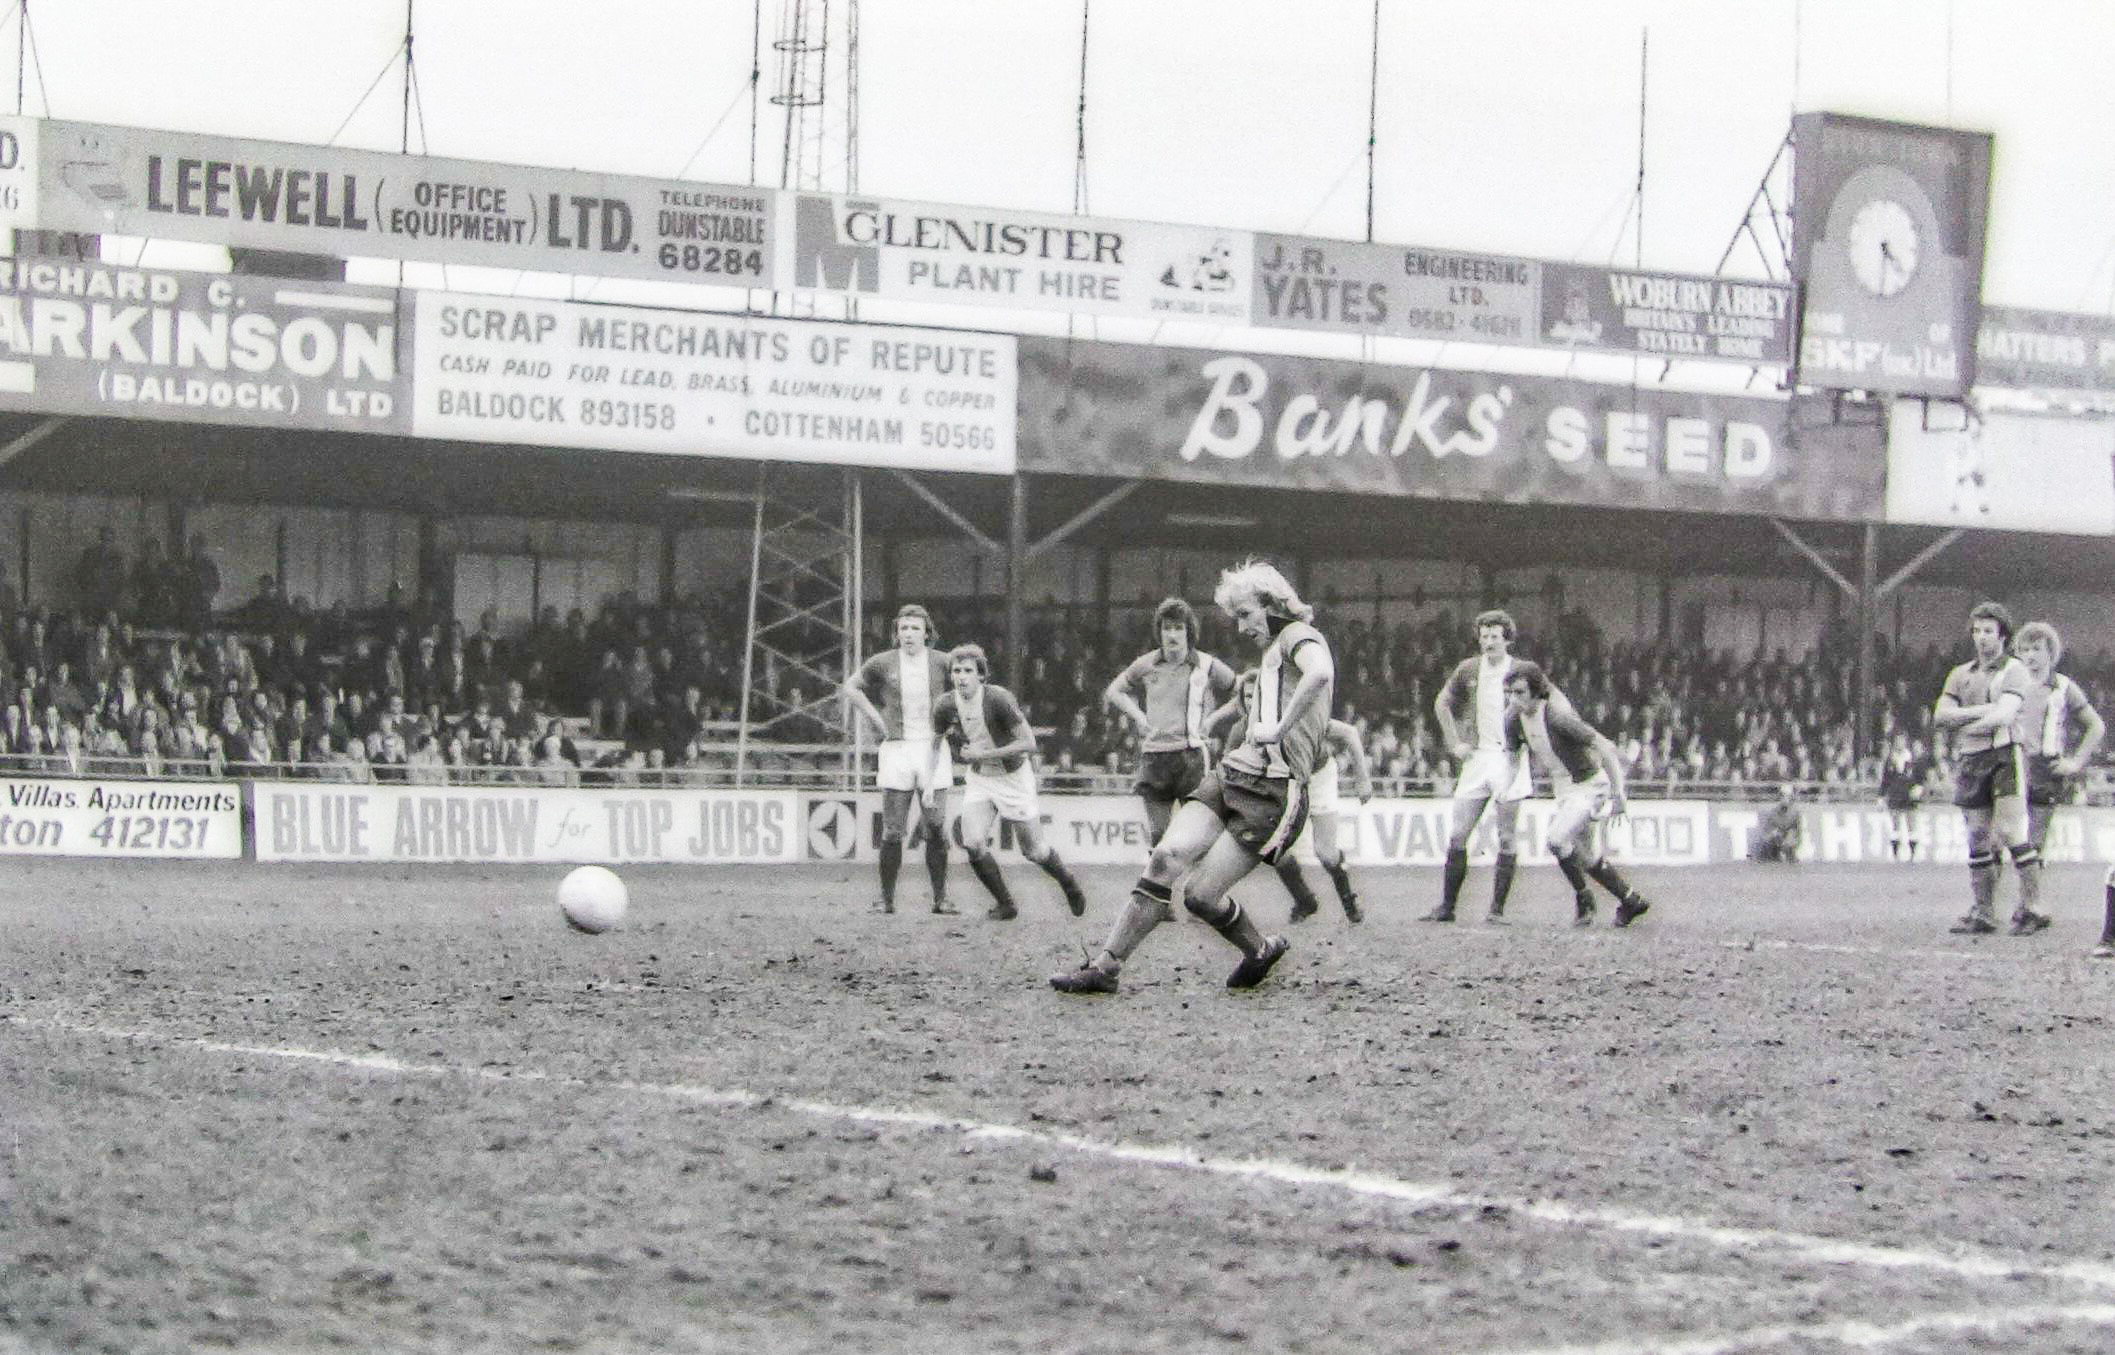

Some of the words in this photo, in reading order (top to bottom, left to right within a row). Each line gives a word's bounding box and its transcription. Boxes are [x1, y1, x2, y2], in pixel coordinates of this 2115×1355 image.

[148, 155, 367, 230] LEEWELL
[548, 194, 640, 253] LTD.
[415, 182, 507, 213] OFFICE
[660, 189, 765, 212] TELEPHONE
[390, 208, 527, 245] EQUIPMENT
[658, 210, 764, 244] DUNSTABLE
[846, 211, 1123, 265] GLENISTER
[659, 243, 763, 275] 68284
[909, 260, 1023, 295] PLANT
[1039, 270, 1121, 302] HIRE
[1404, 251, 1528, 286] ENGINEERING
[1263, 274, 1389, 325] YATES
[1609, 273, 1712, 313] WOBURN
[1716, 281, 1789, 319] ABBEY
[440, 306, 557, 343] SCRAP
[577, 316, 789, 363] MERCHANTS
[809, 335, 851, 366] OF
[871, 339, 996, 378] REPUTE
[98, 369, 299, 414] (BALDOCK)
[326, 388, 392, 418] LTD
[440, 354, 491, 375] CASH
[502, 359, 552, 379] PAID
[567, 364, 610, 384] FOR
[768, 377, 883, 402] ALUMINIUM
[924, 388, 996, 410] COPPER
[438, 388, 565, 423] BALDOCK
[580, 398, 676, 431] 893158
[745, 409, 903, 445] COTTENHAM
[920, 421, 995, 451] 50566
[1545, 406, 1772, 478] SEED
[88, 785, 236, 813] Apartments
[89, 814, 209, 850] 412131
[272, 794, 370, 856] BLUE
[393, 796, 539, 858] ARROW
[548, 806, 592, 849] for
[601, 798, 673, 858] TOP
[688, 799, 784, 857] JOBS
